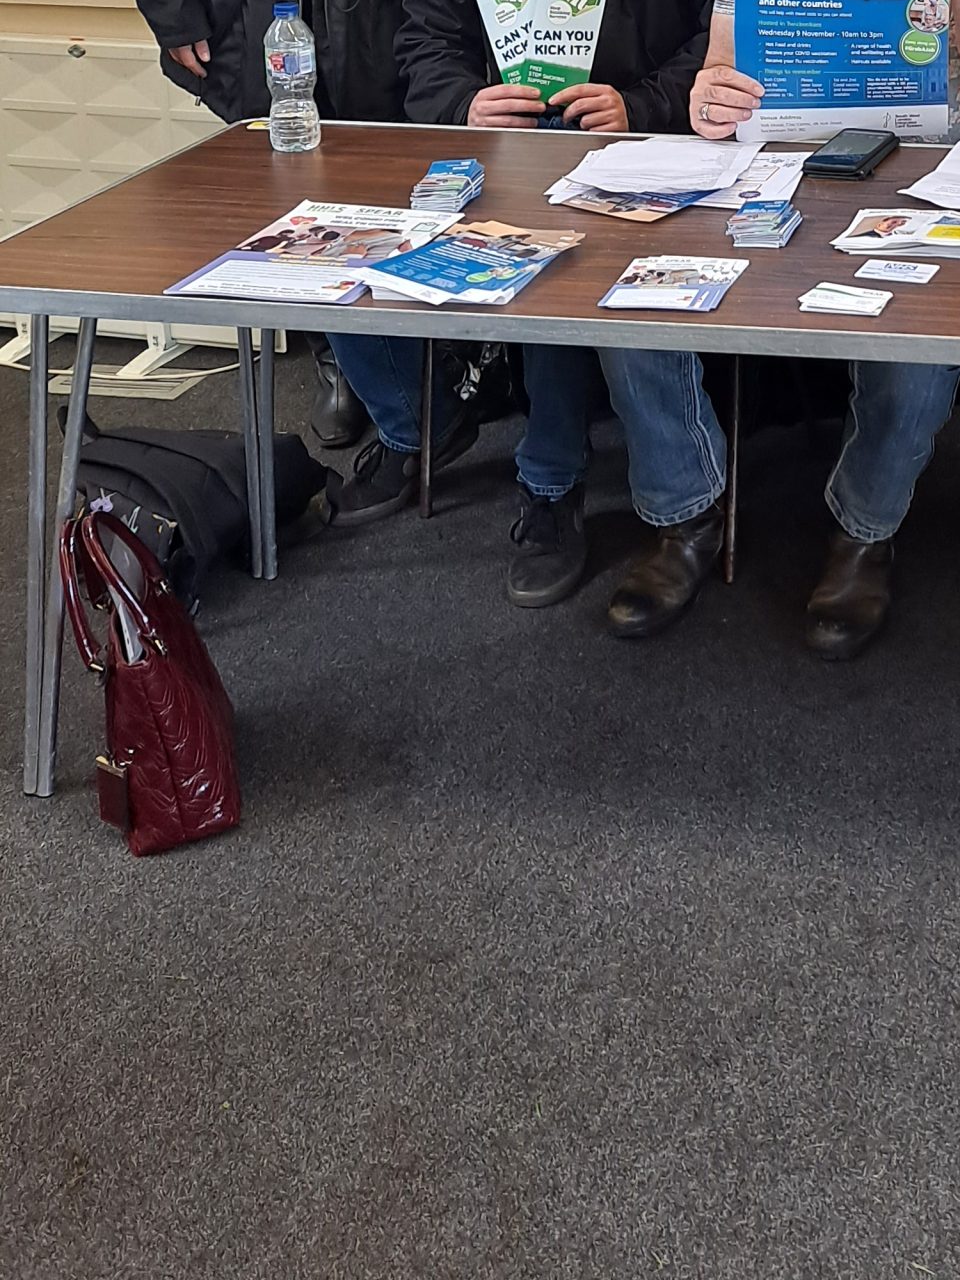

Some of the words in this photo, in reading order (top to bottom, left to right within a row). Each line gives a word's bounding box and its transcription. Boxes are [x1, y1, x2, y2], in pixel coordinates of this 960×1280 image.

[802, 0, 843, 9] countries
[534, 30, 562, 41] CAN
[566, 30, 594, 41] YOU
[758, 29, 795, 38] Wednesday
[802, 30, 836, 38] November
[495, 29, 521, 50] CAN
[535, 45, 566, 55] KICK
[570, 45, 591, 55] IT?
[527, 76, 551, 86] SUPPORT
[542, 73, 565, 83] SMOKING
